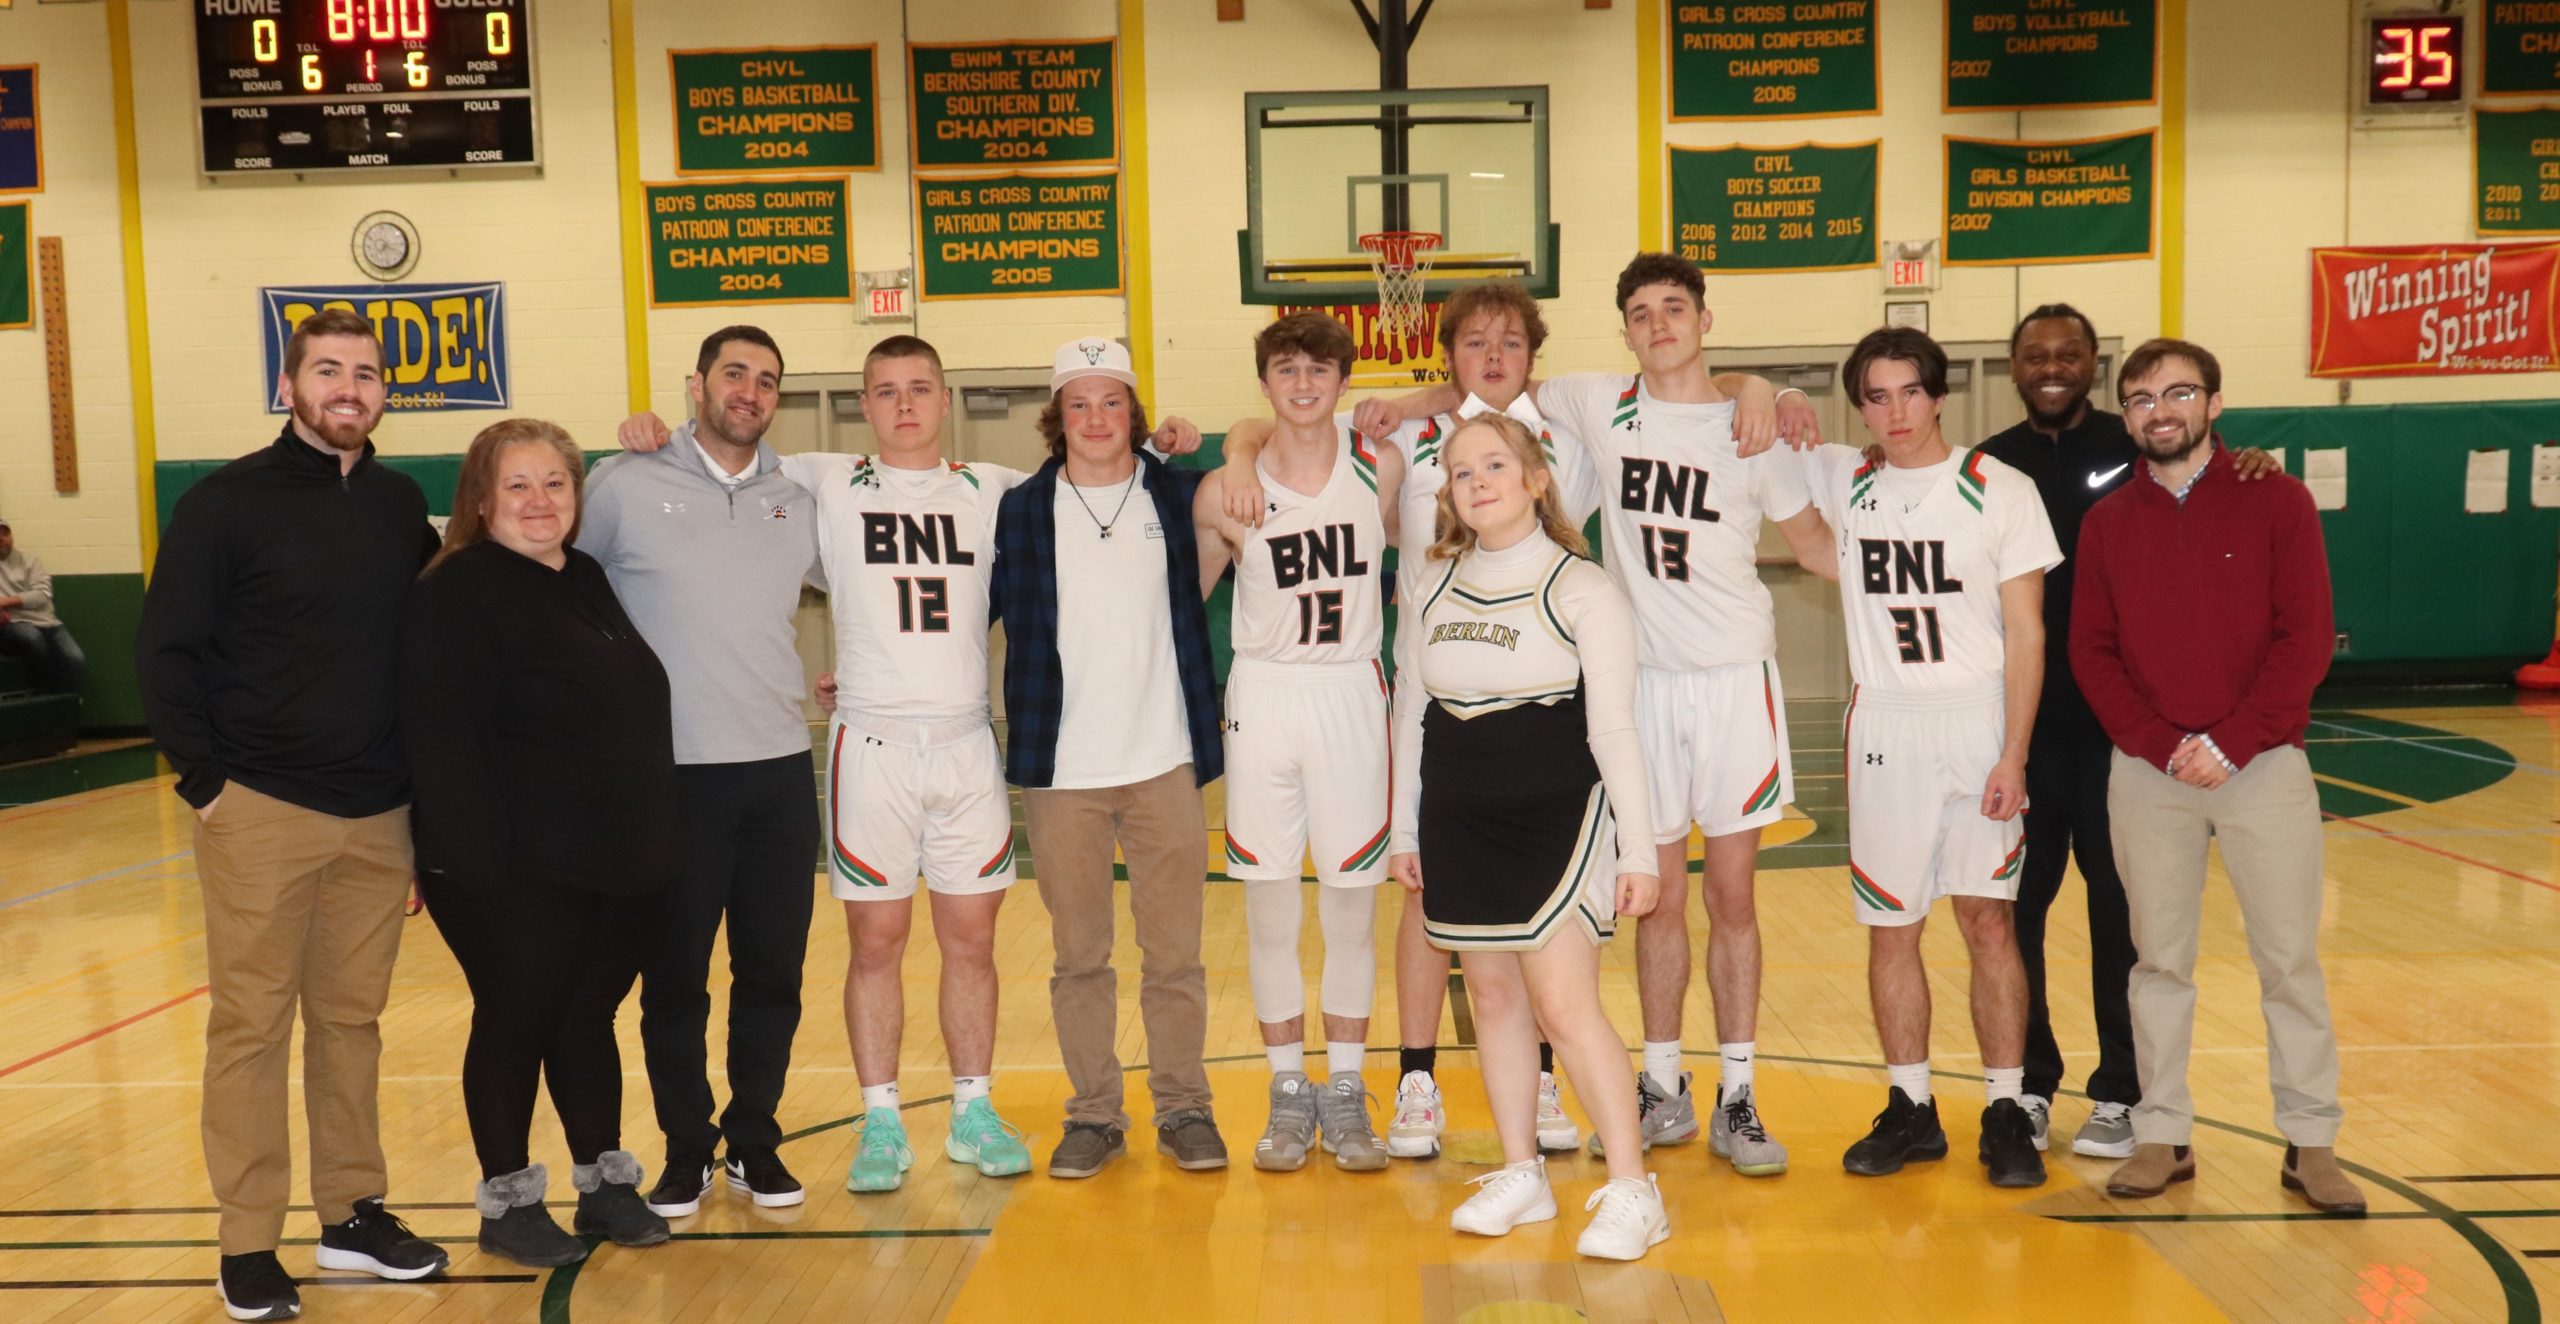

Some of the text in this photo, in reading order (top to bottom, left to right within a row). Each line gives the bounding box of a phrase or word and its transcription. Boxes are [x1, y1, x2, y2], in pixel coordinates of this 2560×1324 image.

[205, 0, 281, 15] HOME
[1679, 2, 1867, 23] GIRLS CROSS COUNTRY
[326, 0, 427, 41] 8:00
[1973, 9, 2130, 32] BOYS VOLLEYBALL
[253, 19, 278, 62] 0
[486, 12, 511, 55] 0
[1684, 28, 1865, 50] PATROON CONFERENCE
[2006, 35, 2098, 53] CHAMPIONS
[366, 49, 374, 81] 1
[467, 61, 498, 71] POSS
[950, 49, 1076, 68] SWIM TEAM
[1729, 58, 1820, 76] CHAMPIONS
[2380, 27, 2452, 87] 35
[229, 68, 259, 78] POSS
[302, 54, 322, 90] 6
[407, 51, 428, 87] 6
[741, 60, 805, 77] CHVL
[1950, 60, 1992, 78] 2007
[243, 81, 283, 91] BONUS
[346, 83, 383, 93] PERIOD
[446, 74, 486, 85] BONUS
[924, 68, 1102, 92] BERKSHIRE COUNTY
[689, 83, 860, 108] BOYS BASKETBALL
[946, 93, 1080, 116] SOUTHERN DIV.
[1754, 85, 1796, 103] 2006
[232, 107, 268, 118] FOULS
[323, 105, 366, 116] PLAYER
[383, 103, 412, 114] FOUL
[464, 100, 500, 111] FOULS
[698, 111, 854, 136] CHAMPIONS
[936, 116, 1094, 139] CHAMPIONS
[349, 154, 389, 165] MATCH
[465, 150, 503, 162] SCORE
[744, 141, 809, 159] 2004
[984, 141, 1048, 159] 2004
[2027, 148, 2075, 164] CHVL
[234, 158, 272, 168] SCORE
[1754, 155, 1793, 173] CHVL
[1971, 164, 2131, 185] GIRLS BASKETBALL
[926, 184, 1111, 206] GIRLS CROSS COUNTRY
[1727, 176, 1821, 196] BOYS SOCCER
[2485, 185, 2522, 203] 2010
[655, 191, 836, 213] BOYS CROSS COUNTRY
[1969, 187, 2132, 208] DIVISION CHAMPIONS
[1733, 200, 1815, 219] CHAMPIONS
[662, 216, 834, 240] PATROON CONFERENCE
[934, 210, 1105, 234] PATROON CONFERENCE
[1681, 217, 1862, 241] 2006 2012 2014 2015
[1950, 214, 1992, 231] 2007
[670, 244, 830, 268] CHAMPIONS
[942, 238, 1099, 262] CHAMPIONS
[1681, 244, 1716, 261] 2016
[720, 273, 782, 291] 2004
[991, 267, 1052, 285] 2005
[1894, 261, 1924, 285] EXIT
[2344, 247, 2496, 321] Winning
[873, 289, 902, 313] EXIT
[2418, 289, 2530, 368] Spirit!
[391, 392, 445, 408] Got It!
[1621, 456, 1721, 523] BNL
[860, 512, 975, 567] BNL
[1265, 523, 1368, 590] BNL
[1639, 524, 1690, 583] 13
[1858, 538, 1963, 595] BNL
[892, 576, 950, 633] 12
[1297, 589, 1343, 645] 15
[1428, 622, 1520, 651] BERLIN
[1887, 606, 1945, 664] 31
